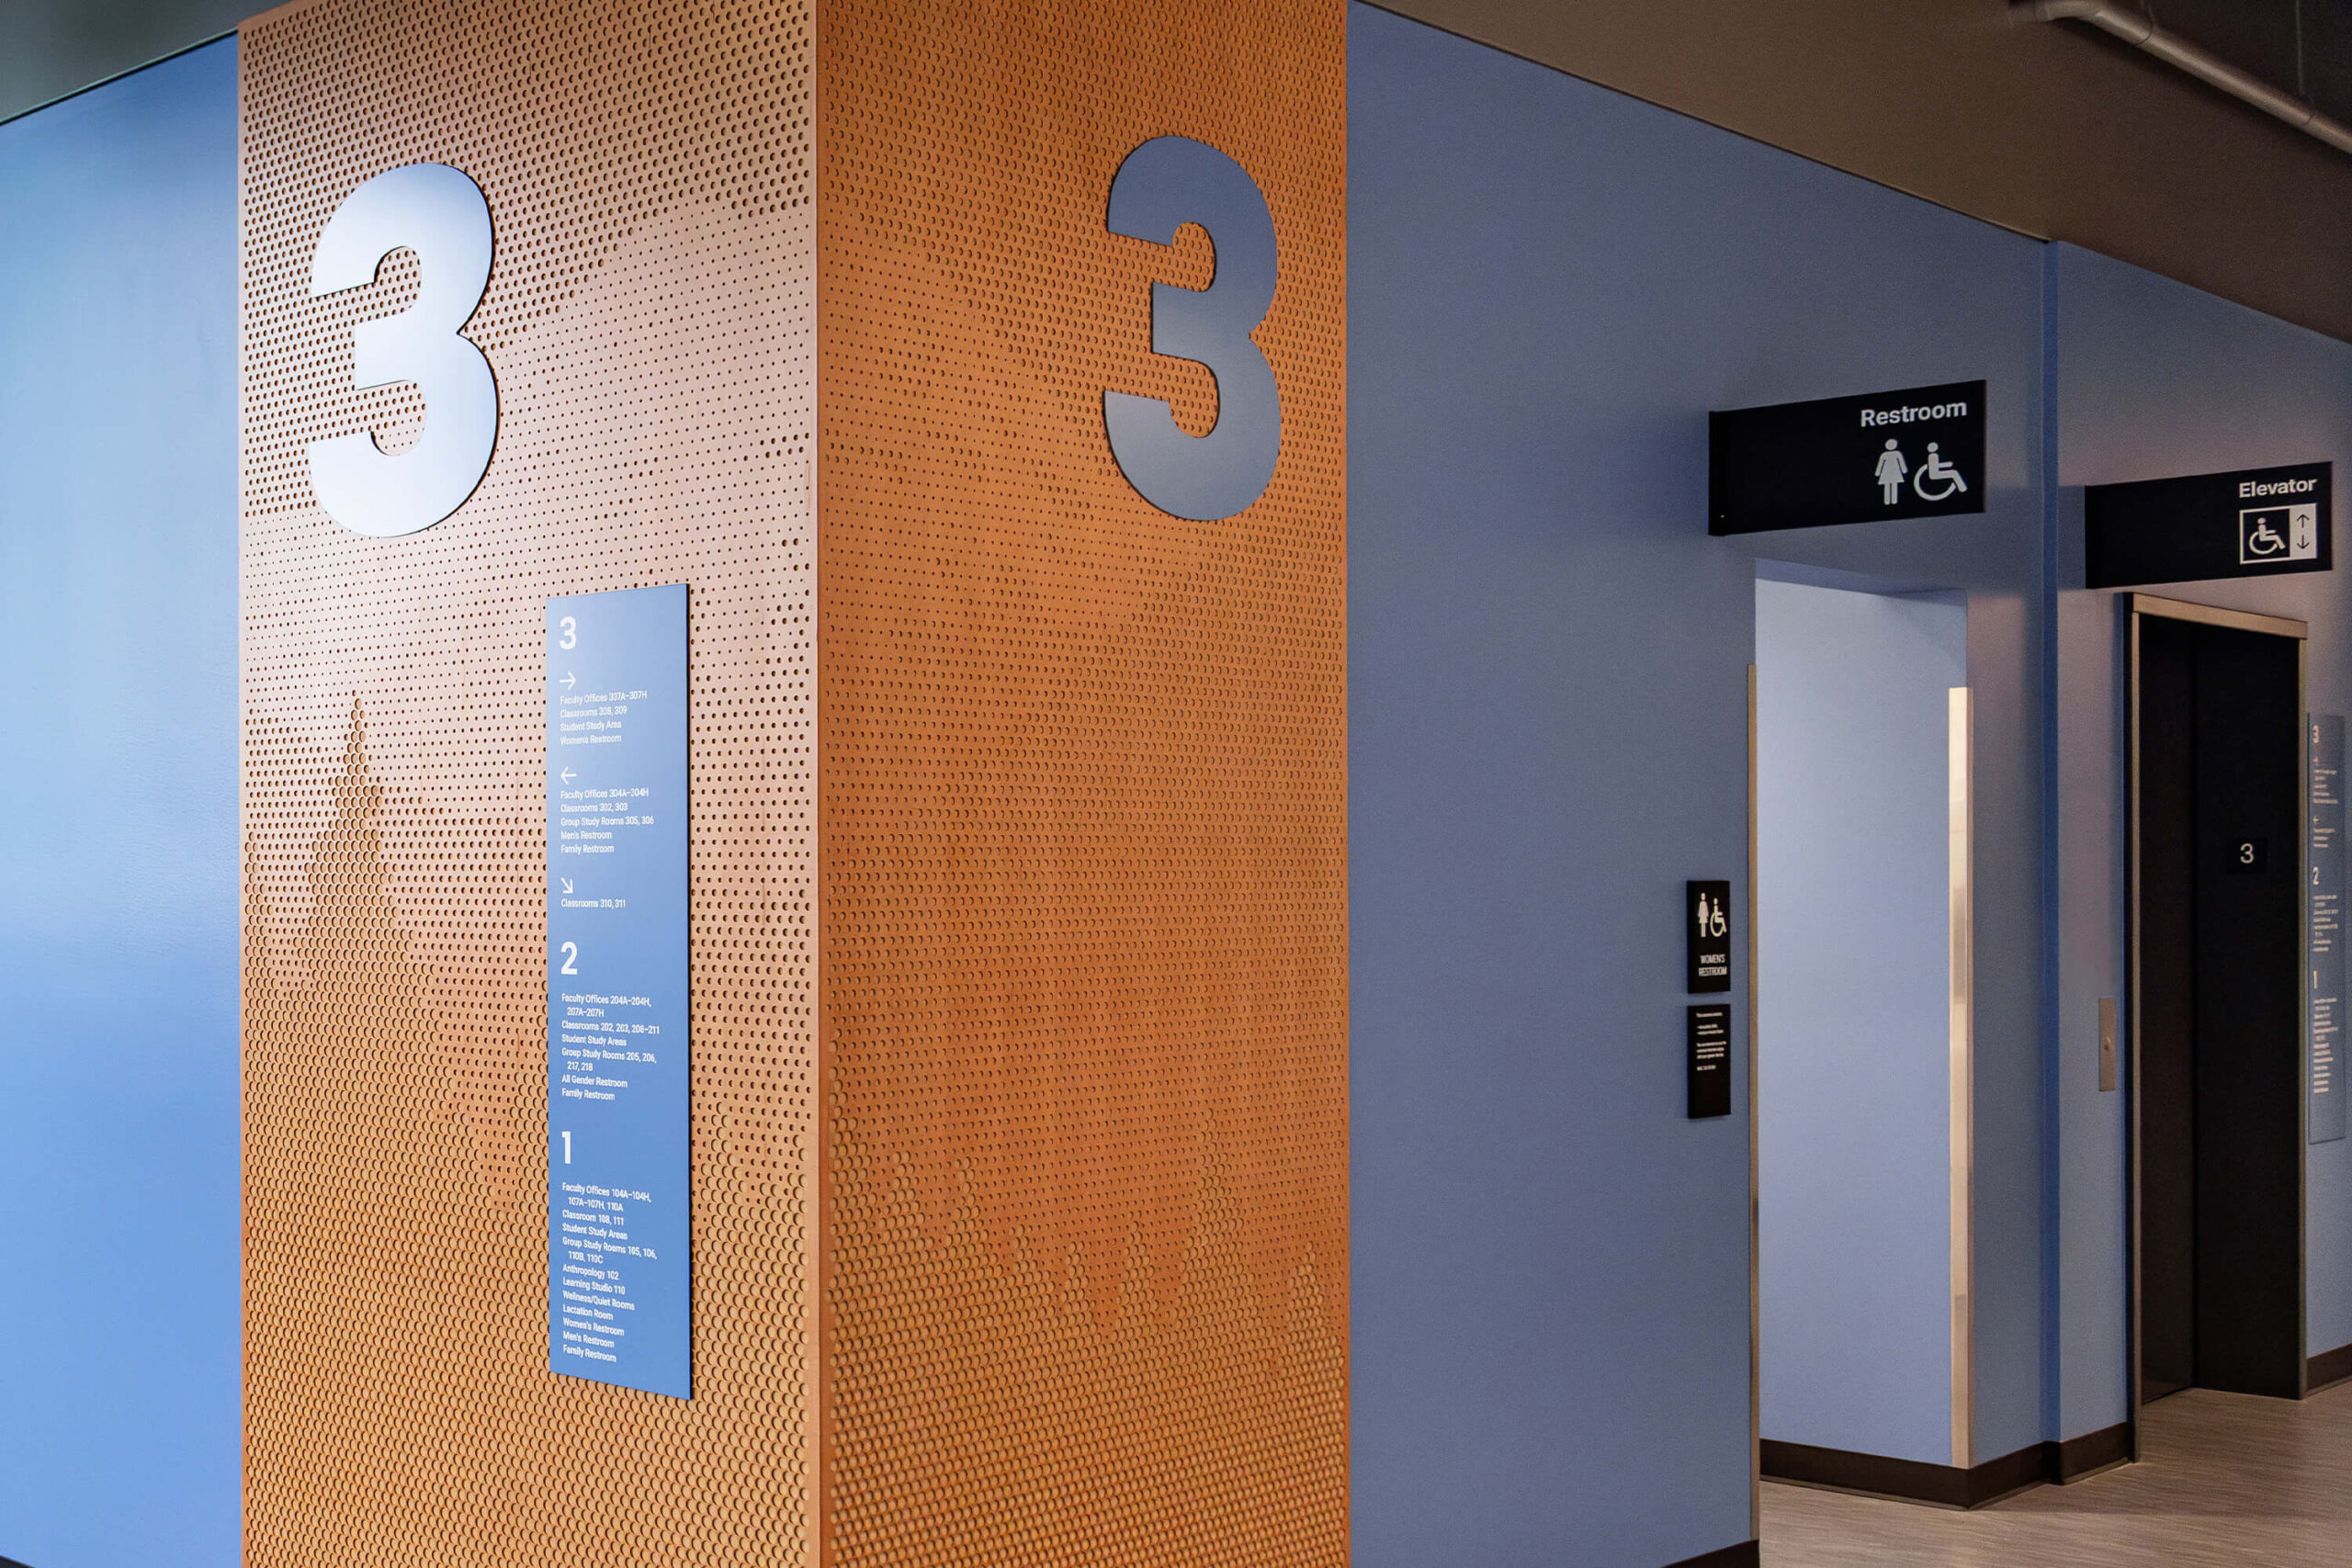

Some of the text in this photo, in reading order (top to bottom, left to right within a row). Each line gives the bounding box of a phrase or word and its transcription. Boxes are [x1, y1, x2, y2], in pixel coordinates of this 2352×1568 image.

[1103, 135, 1281, 521] 3
[308, 162, 500, 538] 3
[1860, 401, 1967, 427] Restroom
[2239, 479, 2317, 498] Elevator
[560, 616, 576, 649] 3
[560, 695, 582, 705] Faculty
[584, 694, 607, 703] Offices
[560, 709, 597, 718] Classrooms
[615, 705, 627, 715] 309
[560, 720, 621, 731] Student Study Area
[591, 735, 621, 743] Restroom
[560, 790, 583, 800] Faculty
[585, 789, 607, 798] Offices
[560, 804, 598, 812] Classrooms
[616, 803, 628, 811] 303
[560, 816, 654, 828] Group Study Rooms 305, 306
[581, 831, 612, 840] Restroom
[561, 844, 614, 855] Family Restroom
[2240, 843, 2255, 863] 3
[2312, 866, 2319, 885] 2
[561, 898, 626, 909] Classrooms 310, 311
[561, 942, 577, 975] 2
[2313, 970, 2318, 988] 1
[562, 993, 584, 1005] Faculty
[586, 995, 608, 1004] Offices
[562, 1021, 599, 1031] Classrooms
[601, 1022, 614, 1032] 202,
[616, 1023, 630, 1033] 203,
[562, 1034, 627, 1046] Student Study Areas
[562, 1048, 656, 1064] Group Study Rooms 205, 206,
[567, 1061, 593, 1071] 217, 218
[571, 1075, 594, 1085] Gender
[596, 1077, 628, 1088] Restroom
[562, 1088, 615, 1100] Family Restroom
[561, 1132, 571, 1164] 1
[562, 1182, 584, 1195] Faculty
[586, 1185, 609, 1196] Offices
[607, 1201, 623, 1212] 110A
[562, 1210, 596, 1222] Classroom
[614, 1216, 624, 1225] 111
[562, 1223, 628, 1240] Student Study Areas
[562, 1236, 657, 1259] Group Study Rooms 105, 106,
[568, 1251, 603, 1264] 110B, 110C
[562, 1264, 619, 1280] Anthropology 102
[563, 1277, 625, 1295] Learning Studio 110
[563, 1290, 635, 1310] Wellness/Quiet Rooms
[563, 1304, 613, 1320] Lactation Room
[563, 1317, 624, 1336] Women's Restroom
[563, 1331, 614, 1348] Men's Restroom
[563, 1344, 616, 1362] Family Restroom
